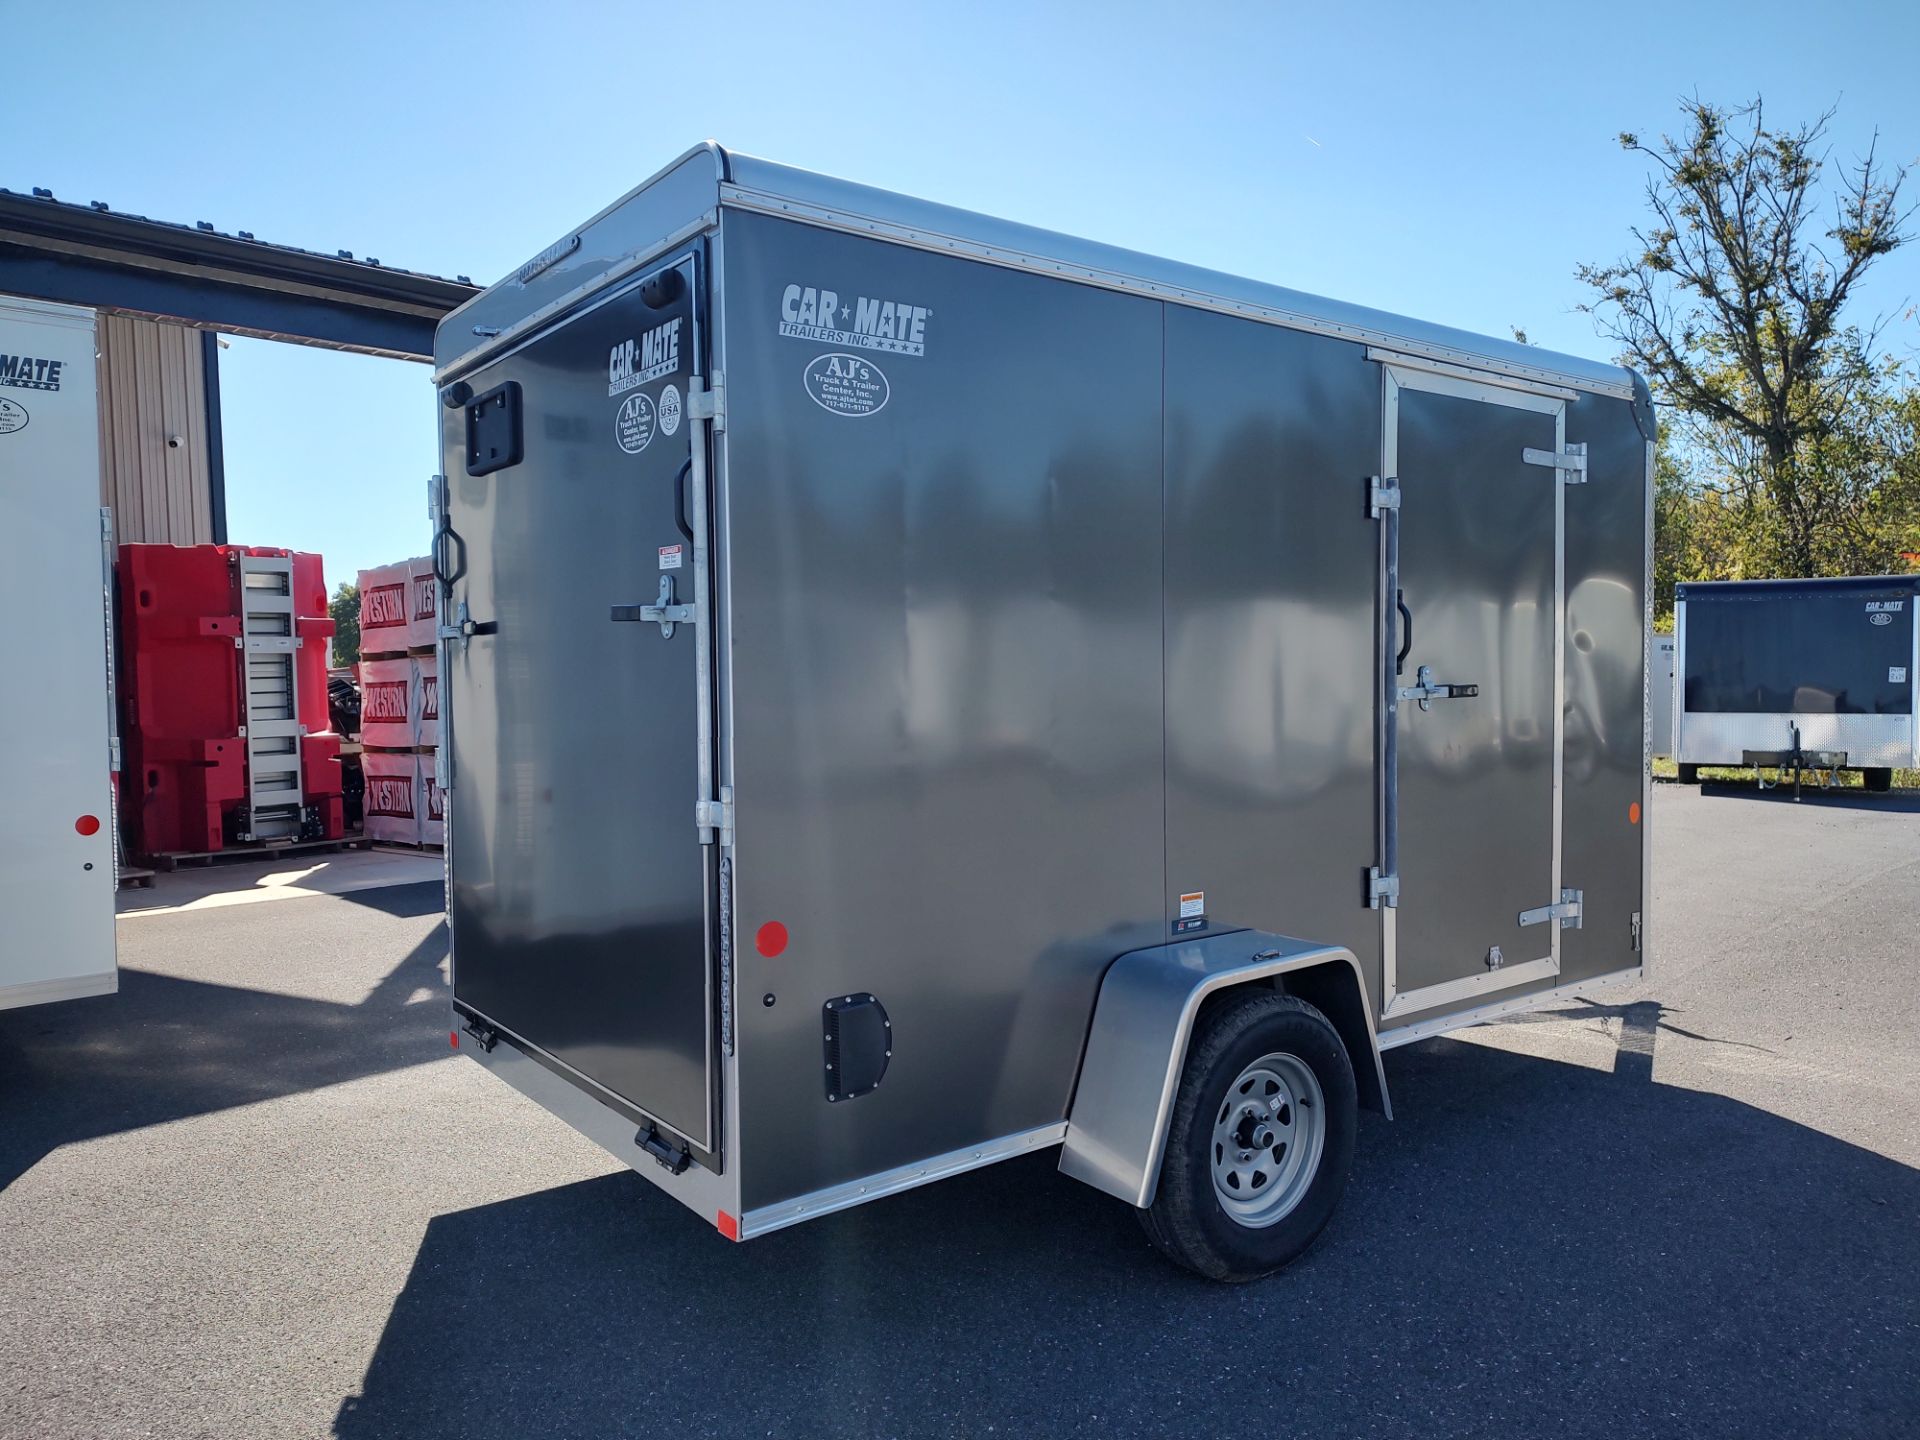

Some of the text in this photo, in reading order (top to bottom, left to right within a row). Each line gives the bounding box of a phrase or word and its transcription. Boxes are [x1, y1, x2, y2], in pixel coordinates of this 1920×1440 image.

[781, 284, 927, 343] CAR MATE
[781, 322, 873, 347] TRAILERS INC.
[609, 317, 679, 383] CAR MATE
[825, 356, 870, 380] AJ's
[609, 374, 638, 394] TRAILERS
[814, 373, 881, 391] Truck & Trailer
[822, 383, 873, 398] Center, Inc.
[625, 397, 646, 420] AJ's
[660, 404, 679, 417] USA
[362, 588, 404, 623] WESTERN
[367, 686, 406, 718] WESTERN
[370, 780, 411, 812] WESTERN
